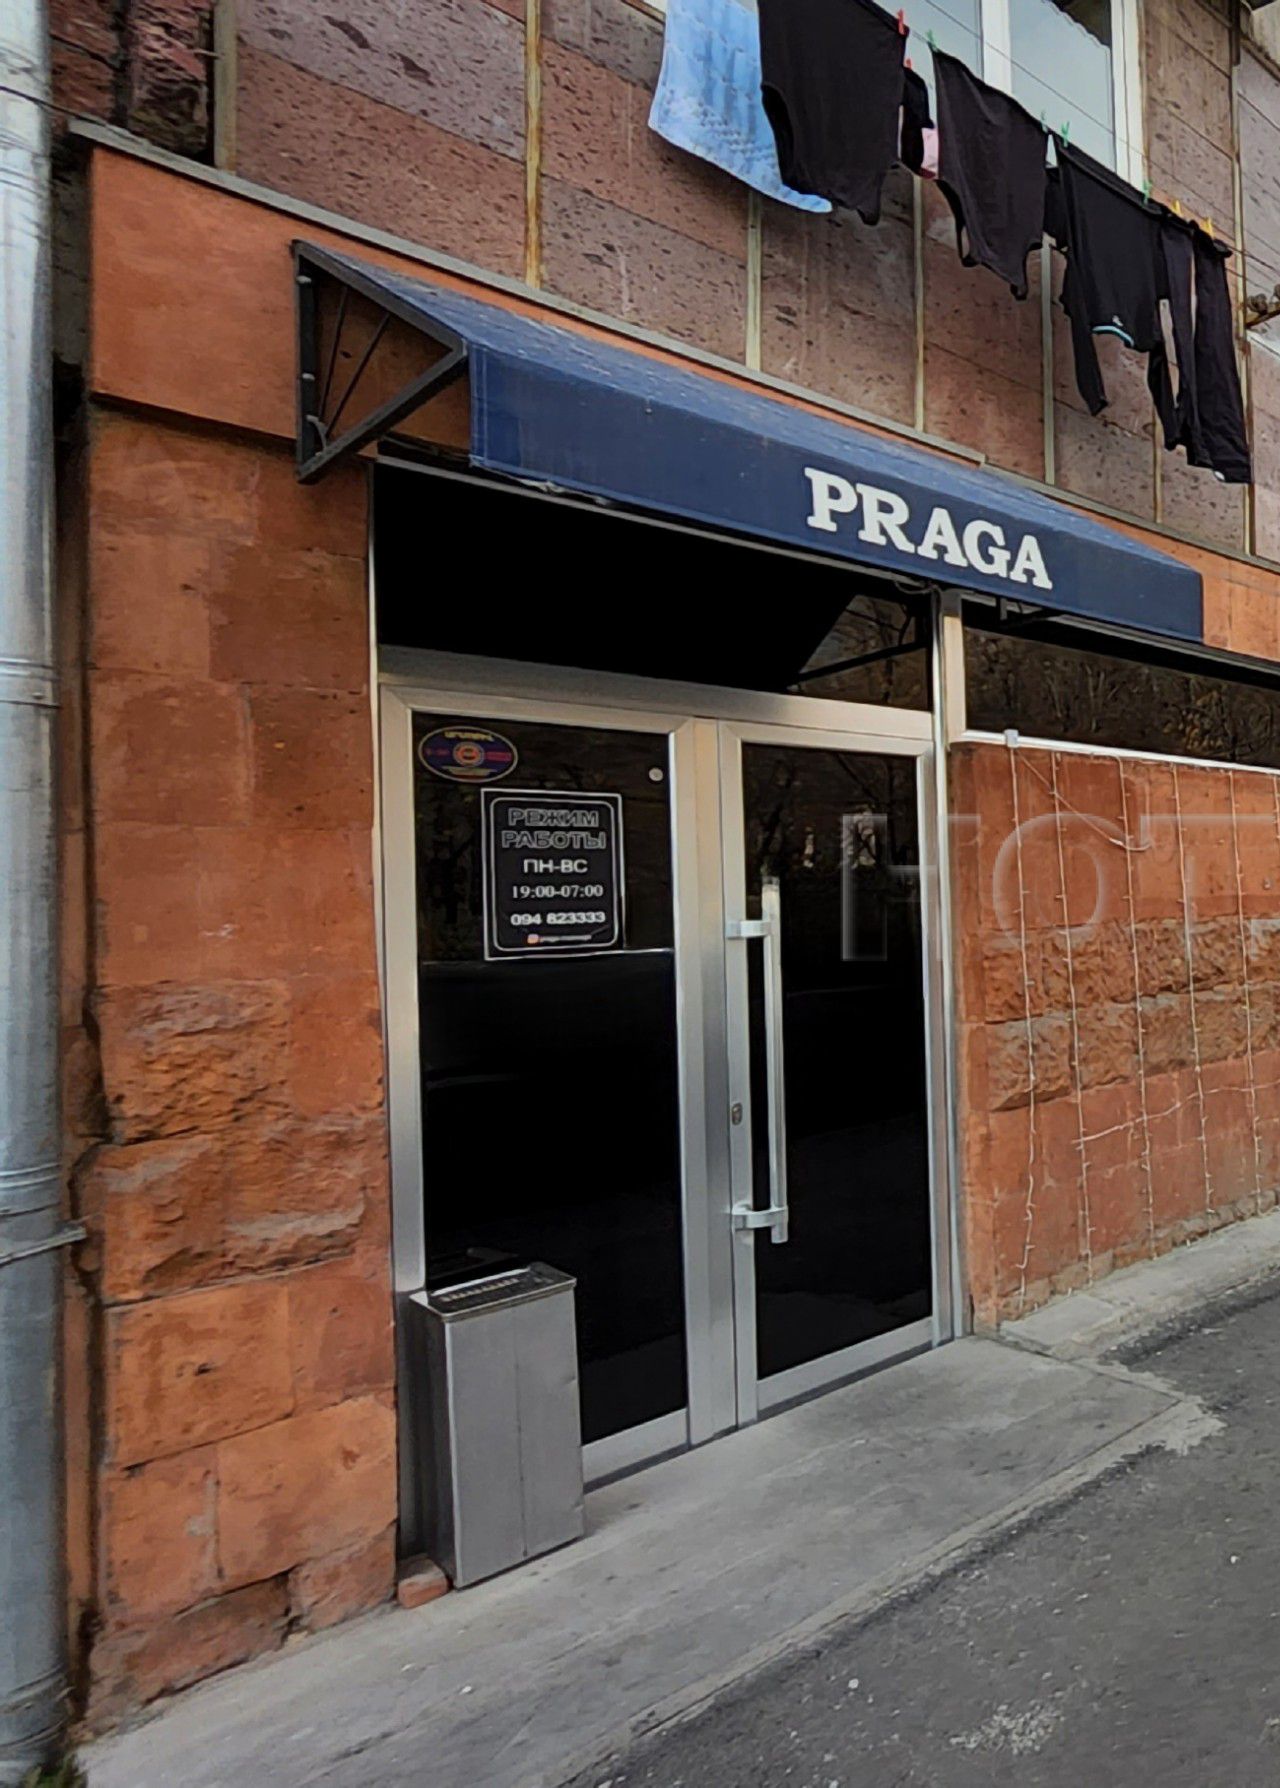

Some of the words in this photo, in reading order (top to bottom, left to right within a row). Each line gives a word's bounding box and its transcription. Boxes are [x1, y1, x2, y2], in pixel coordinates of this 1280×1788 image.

[804, 466, 1053, 590] PRAGA
[508, 807, 599, 827] РЕЖИМ
[501, 830, 606, 849] РАБОТЫ
[523, 858, 588, 873] ПН-ВС
[512, 885, 604, 899] 19:00-07:00
[510, 913, 542, 926] 094
[546, 911, 606, 924] 823333
